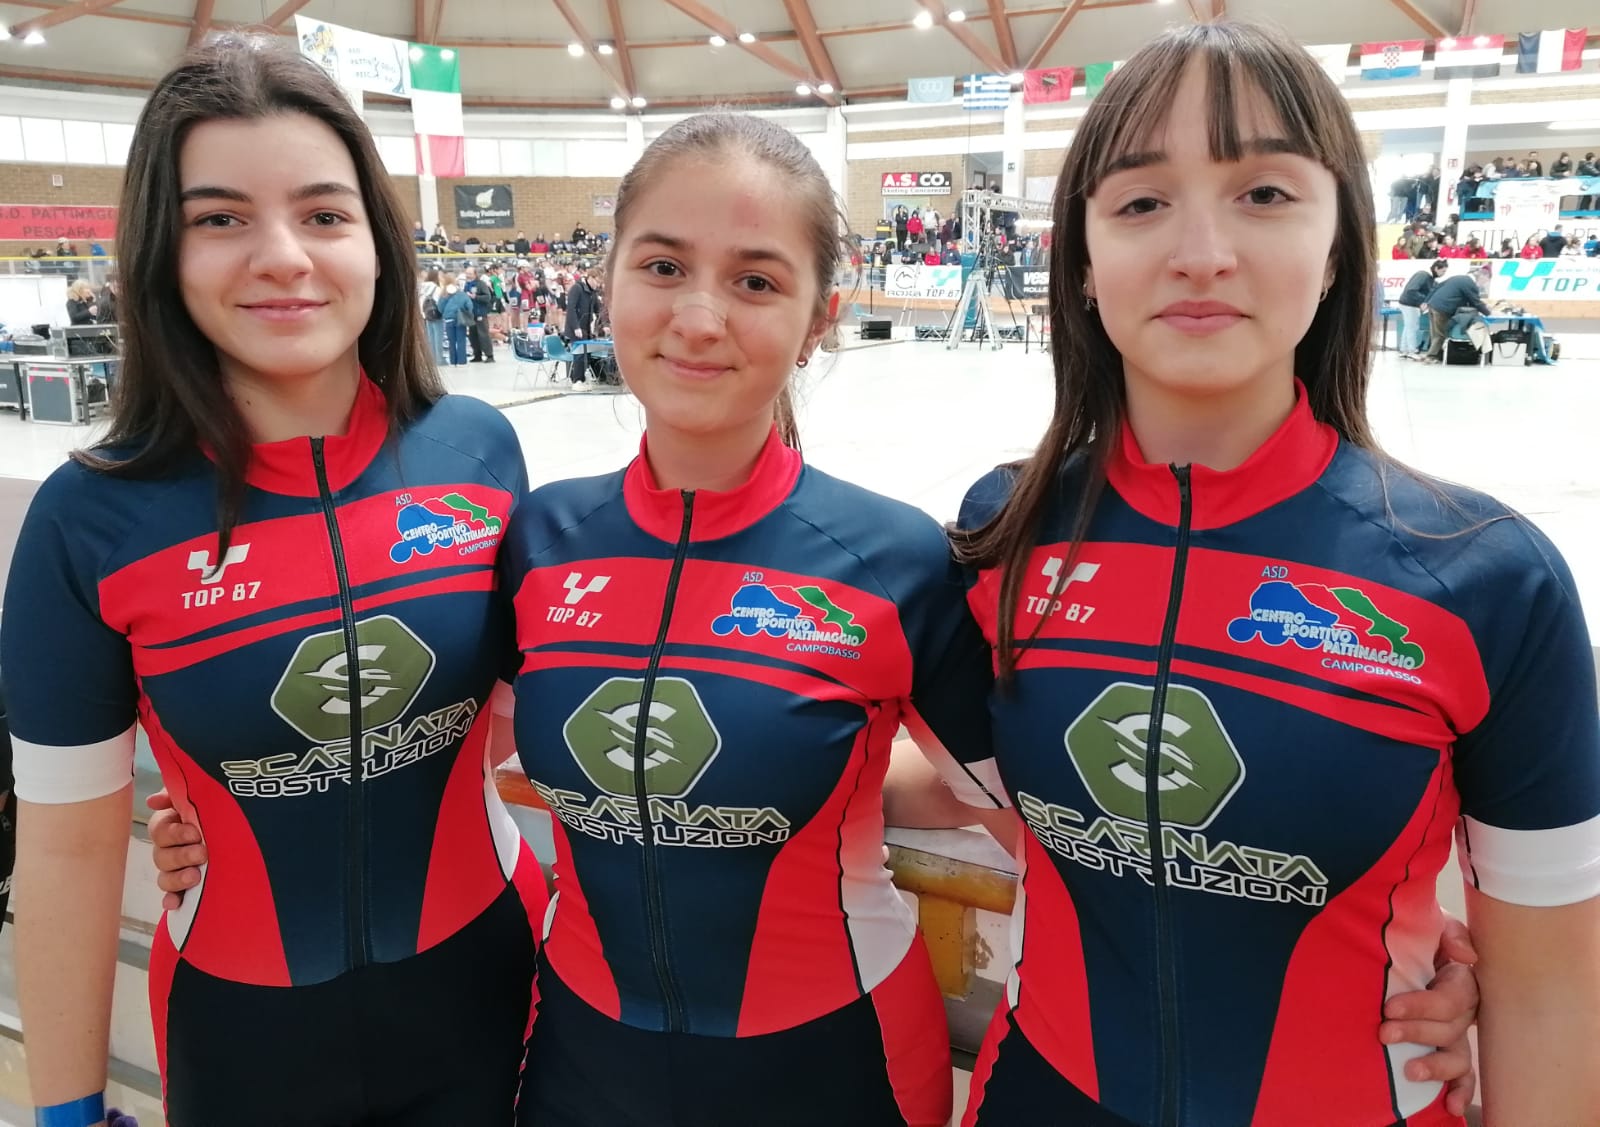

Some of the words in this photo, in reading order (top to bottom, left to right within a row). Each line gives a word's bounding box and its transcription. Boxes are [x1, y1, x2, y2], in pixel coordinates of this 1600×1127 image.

[883, 173, 916, 187] A.S.
[919, 173, 950, 186] CO.
[23, 226, 97, 238] PESCARA
[1541, 277, 1588, 292] TOP
[395, 493, 413, 507] ASD
[403, 522, 438, 541] CENTRO
[427, 523, 467, 544] SPORTIVO
[454, 525, 499, 545] PATTINAGGIO
[742, 571, 764, 583] ASD
[1261, 565, 1289, 579] ASD
[181, 587, 225, 609] TOP
[232, 581, 261, 602] 87
[546, 606, 575, 623] TOP
[575, 610, 602, 628] 87
[732, 606, 775, 619] CENTRO
[1026, 595, 1062, 616] TOP
[1065, 603, 1096, 623] 87
[1251, 608, 1306, 625] CENTRO
[756, 617, 811, 631] SPORTIVO
[1282, 623, 1352, 643] SPORTIVO
[788, 629, 860, 647] PATTINAGGIO
[786, 642, 861, 660] CAMPOBASSO
[1322, 638, 1416, 670] PATTINAGGIO
[1321, 658, 1423, 685] CAMPOBASSO
[1017, 791, 1328, 885] SCARNATA
